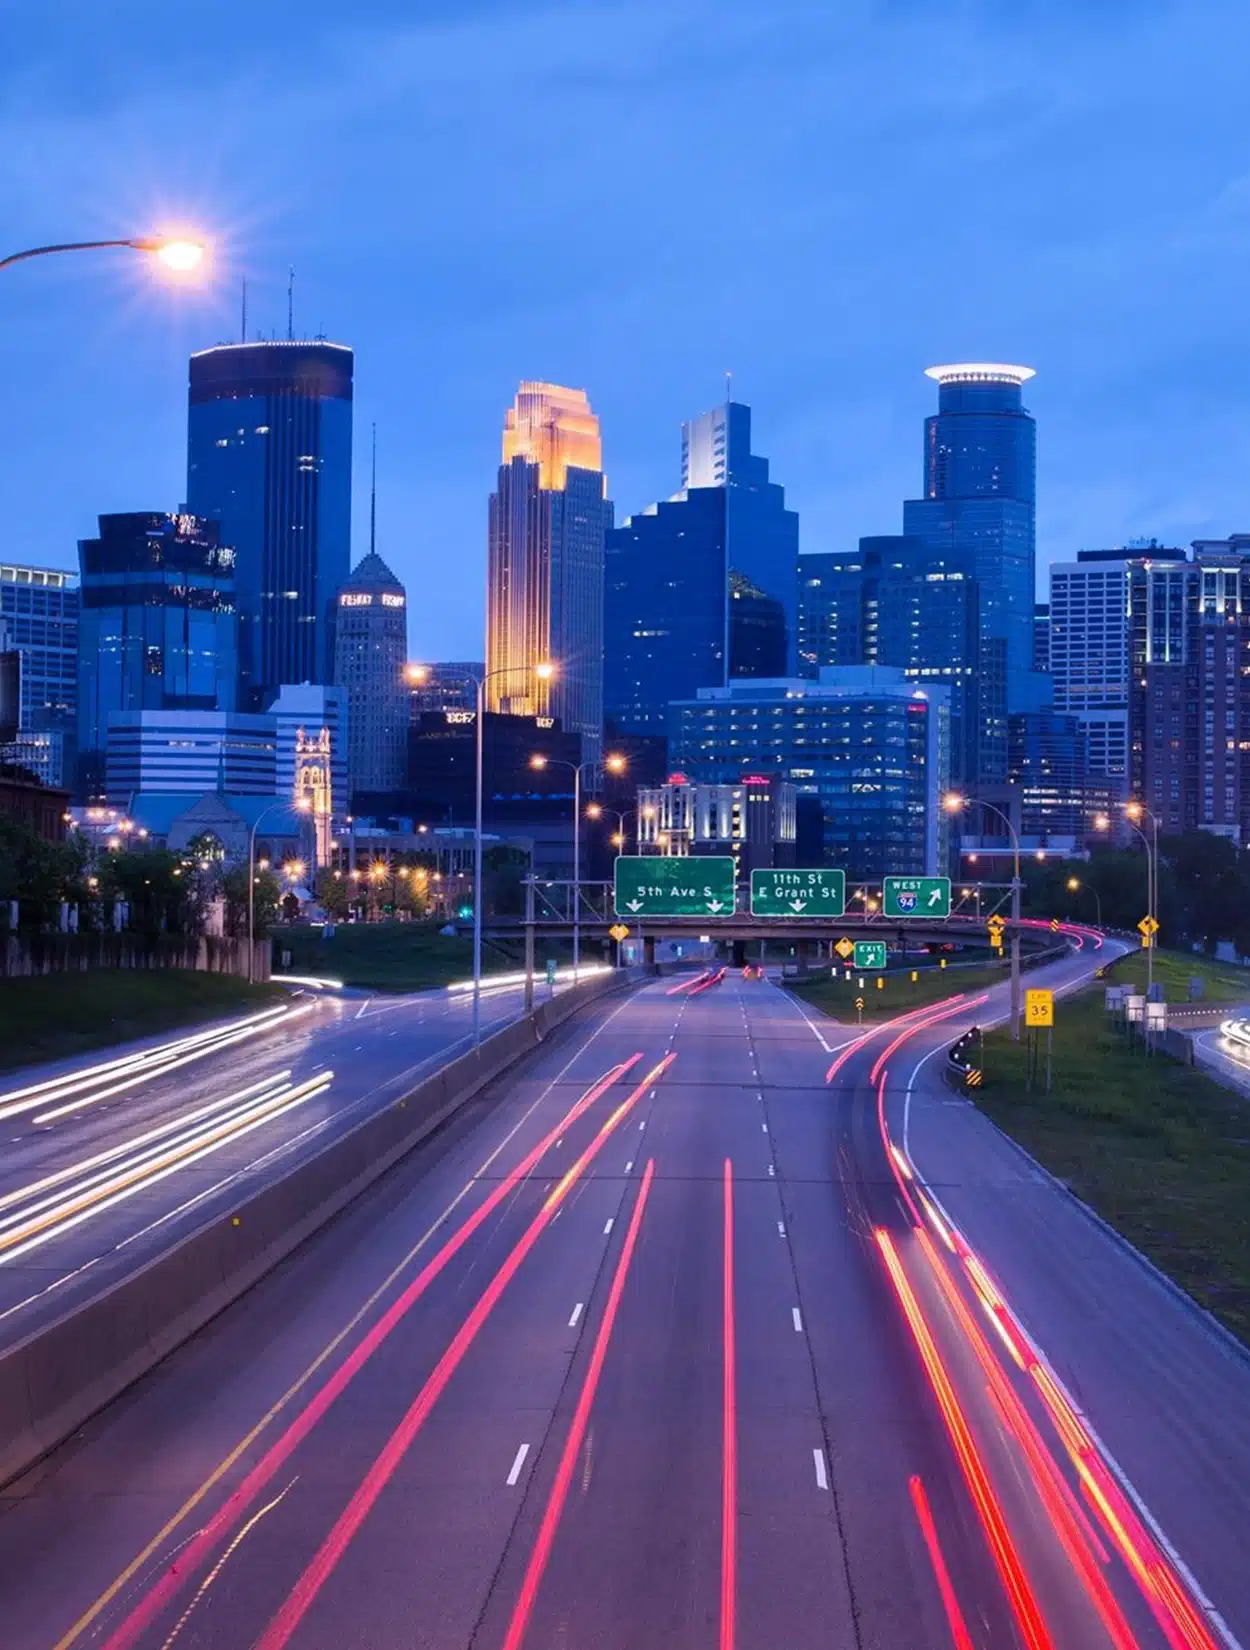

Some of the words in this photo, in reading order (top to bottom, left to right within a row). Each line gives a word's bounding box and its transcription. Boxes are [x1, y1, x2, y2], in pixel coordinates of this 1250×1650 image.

[773, 873, 800, 884] 11th
[808, 873, 823, 884] St
[892, 881, 922, 889] WEST
[637, 886, 663, 897] 5th
[670, 886, 696, 897] Ave
[703, 886, 712, 897] S
[759, 886, 768, 898] E
[775, 887, 814, 898] Grant
[821, 887, 836, 898] St
[899, 897, 914, 908] 94
[859, 945, 883, 953] EXIT
[1031, 1004, 1049, 1017] 35
